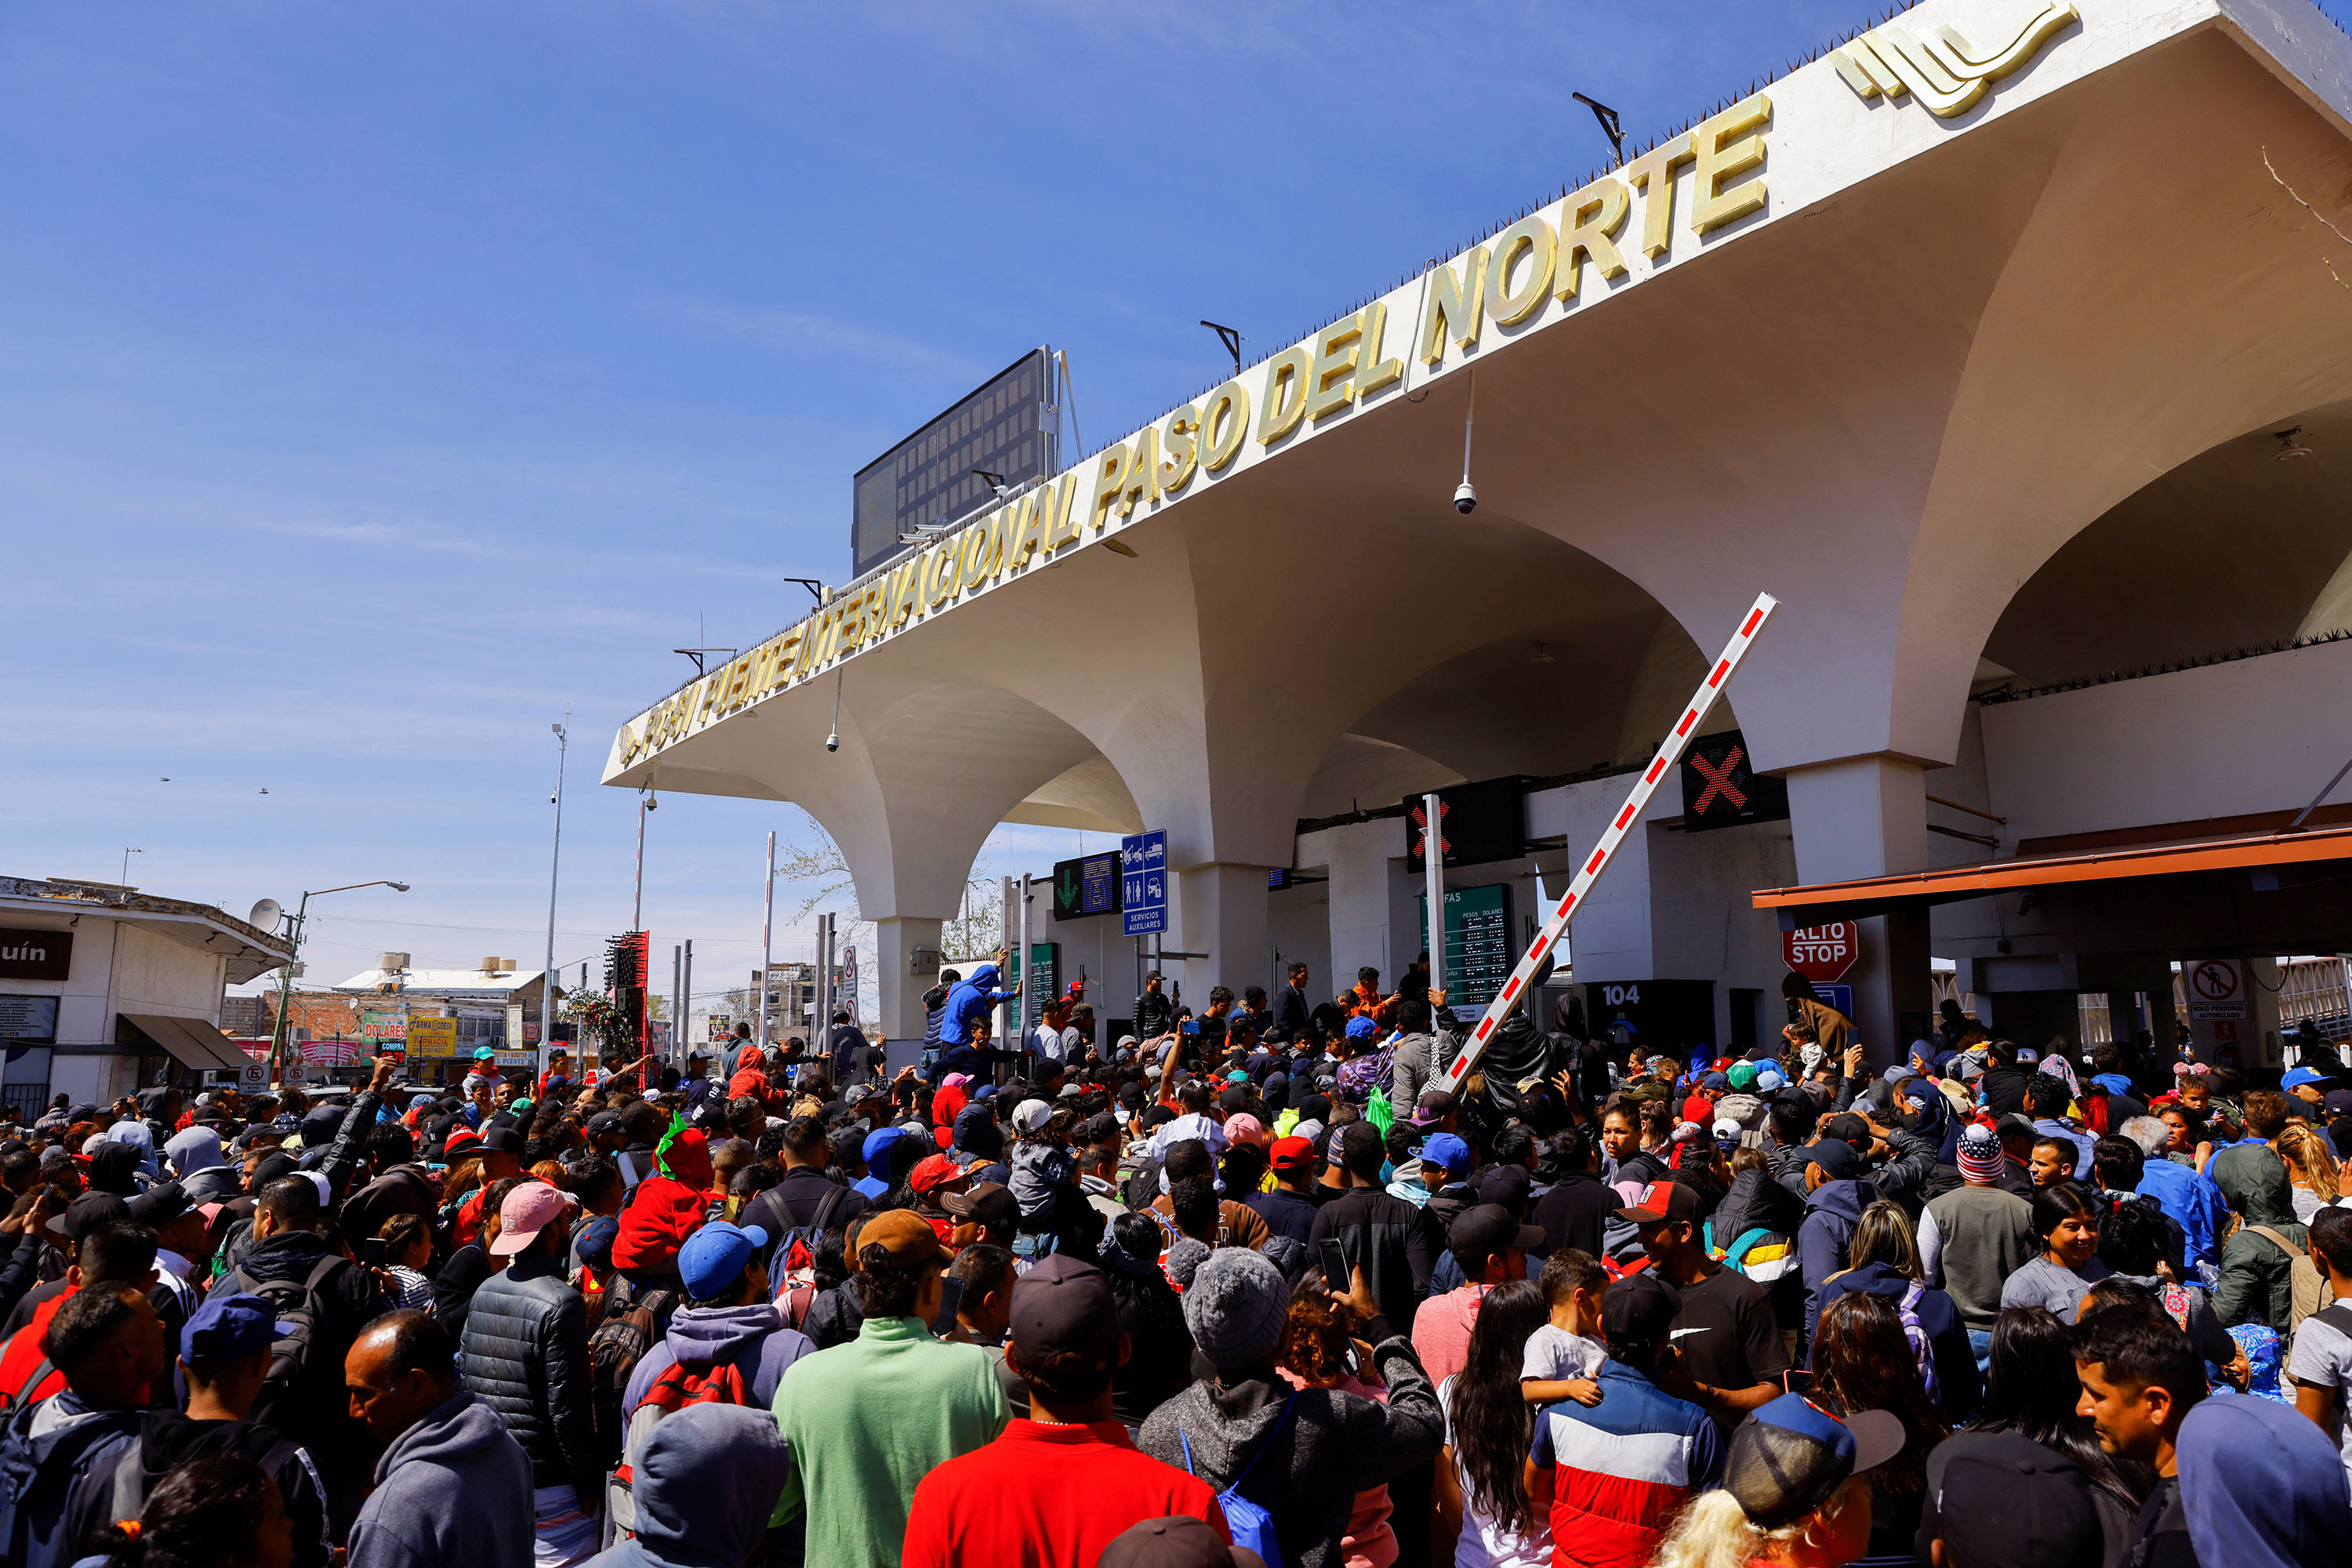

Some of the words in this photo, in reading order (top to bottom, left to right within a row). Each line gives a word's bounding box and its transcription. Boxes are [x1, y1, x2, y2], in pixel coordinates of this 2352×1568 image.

[697, 626, 803, 724] PUENTE
[792, 472, 1081, 676] INTERNACIONAL
[1088, 379, 1250, 529] PASO
[1256, 301, 1403, 446] DEL
[1420, 92, 1773, 366] NORTE
[1129, 920, 1161, 931] AUXILIARES
[1131, 911, 1159, 922] SERVICIOS
[1792, 922, 1845, 940] ALTO
[1792, 945, 1846, 963] STOP
[1602, 985, 1640, 1005] 104
[365, 1023, 406, 1038] DOLARES
